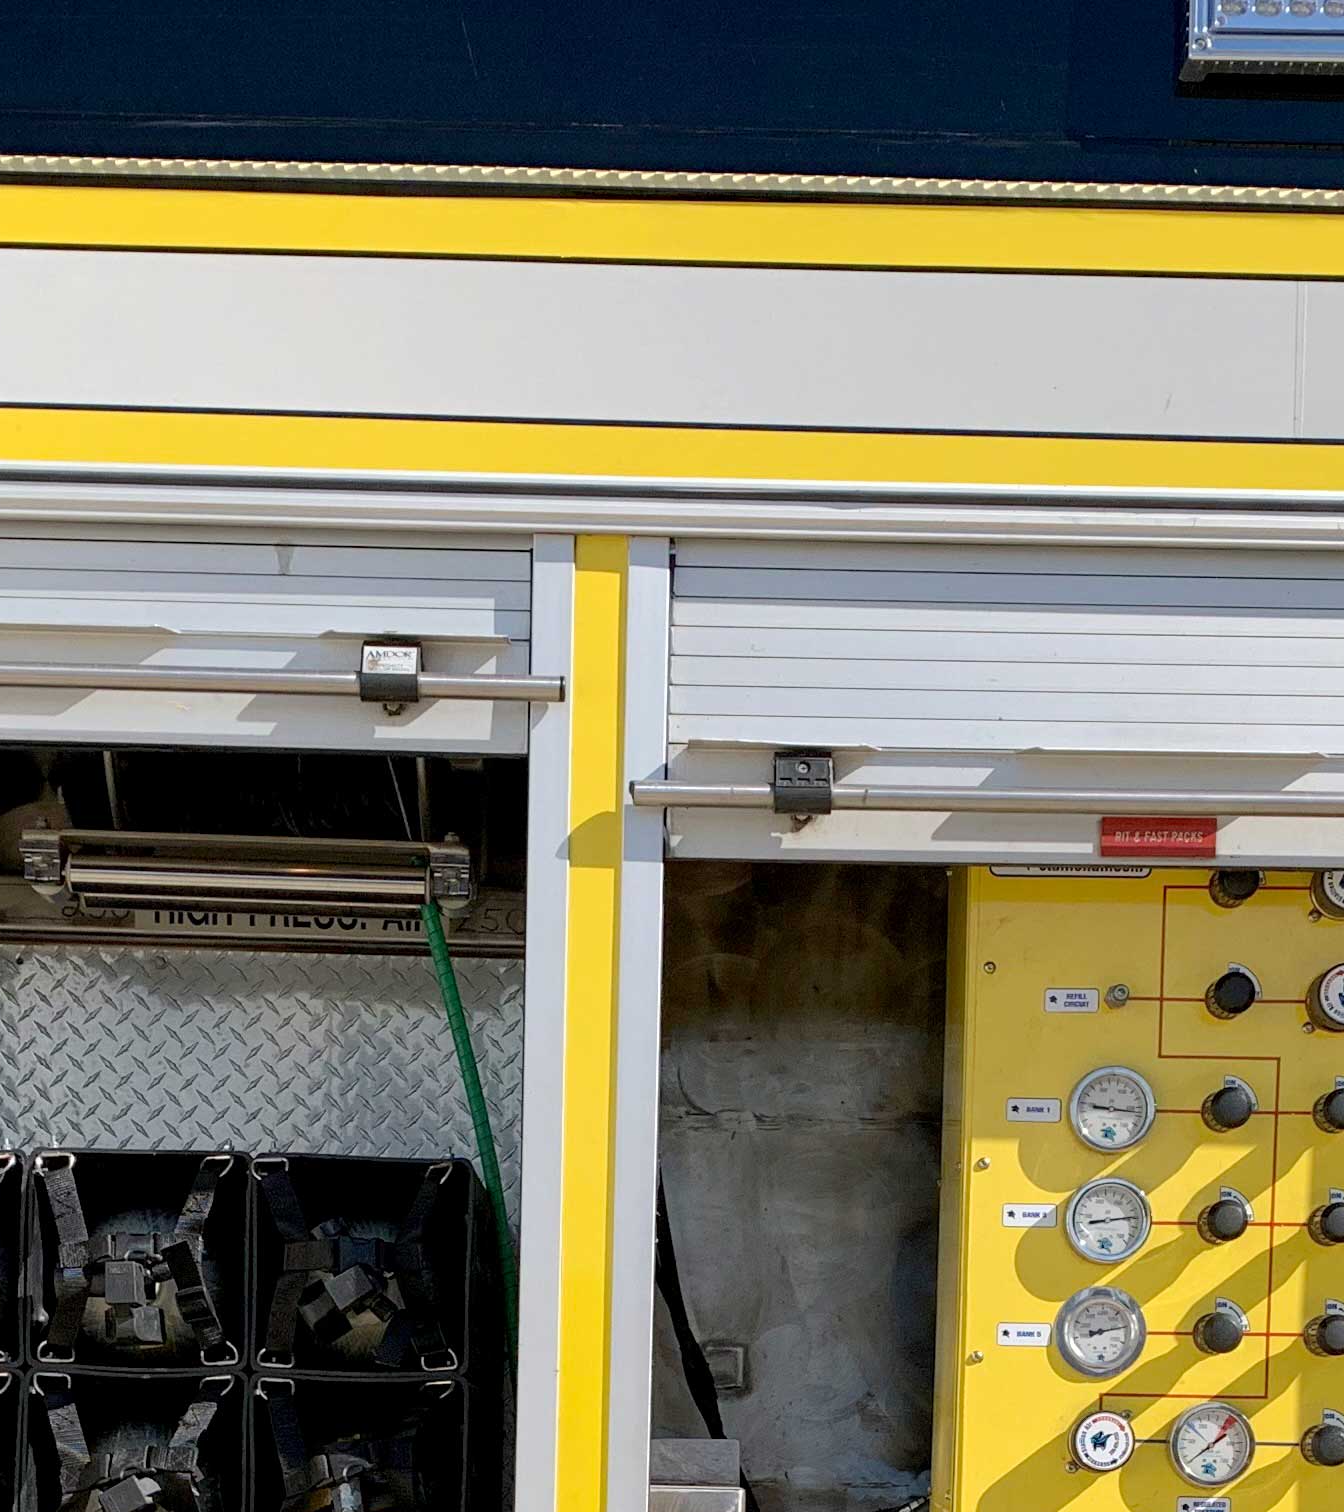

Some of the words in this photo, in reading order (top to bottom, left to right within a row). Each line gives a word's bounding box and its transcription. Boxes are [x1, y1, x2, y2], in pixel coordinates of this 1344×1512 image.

[366, 650, 412, 659] AMDOR
[1114, 831, 1130, 843] RIT
[1133, 831, 1140, 843] &
[1144, 831, 1168, 843] FAST
[1171, 831, 1204, 843] PACKS
